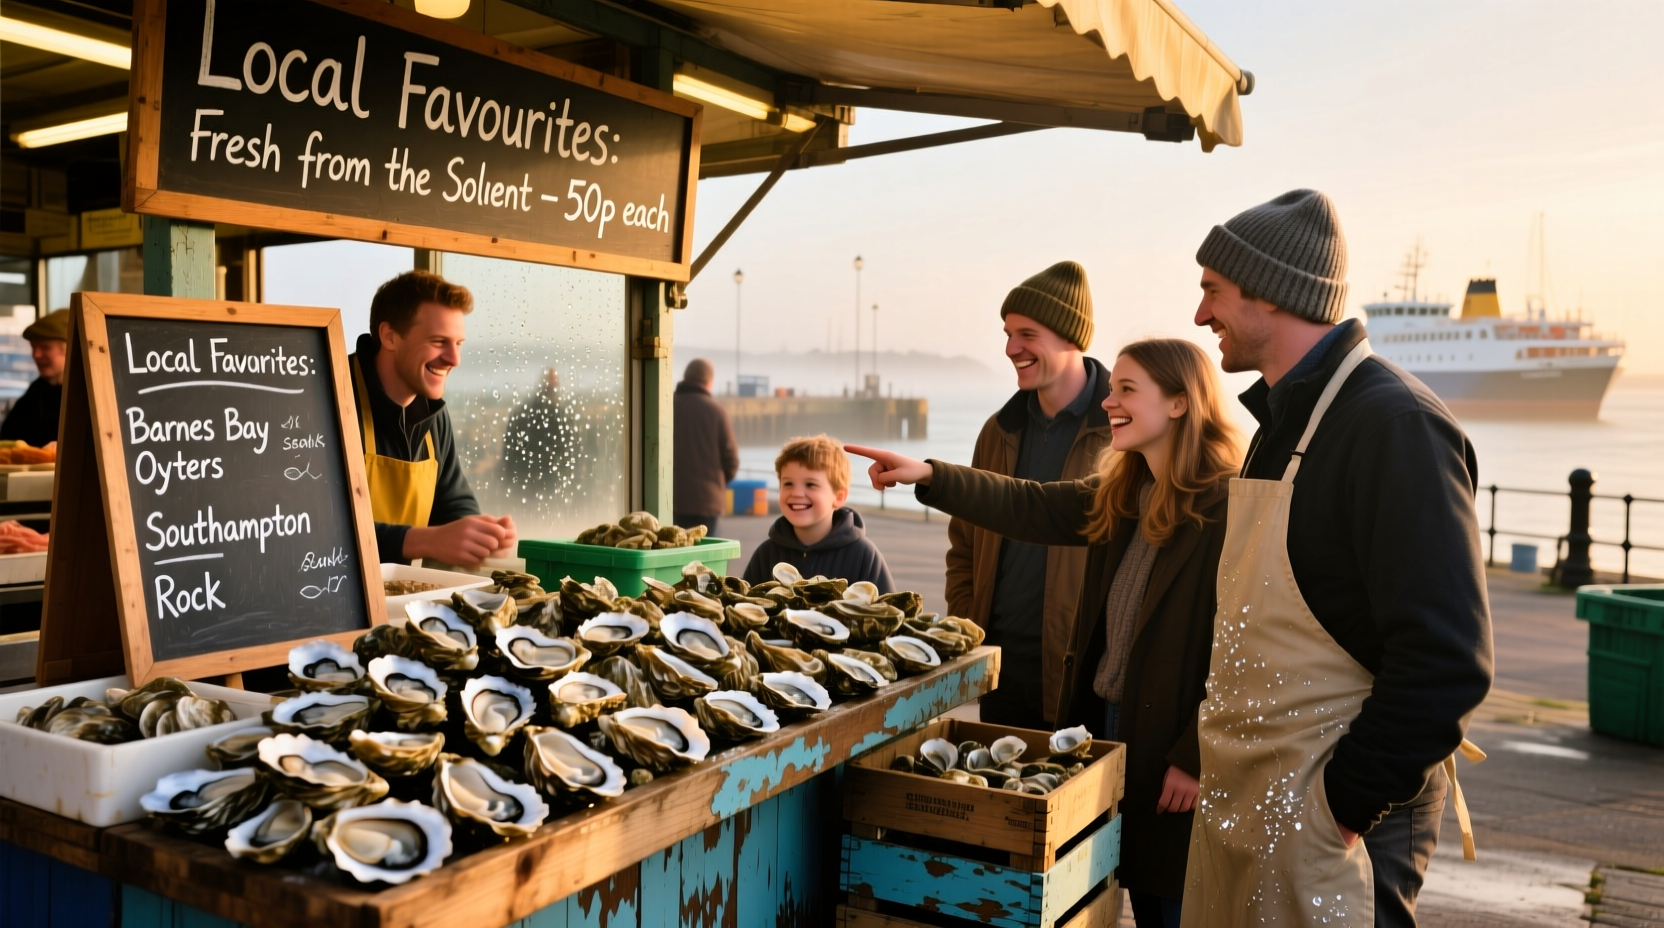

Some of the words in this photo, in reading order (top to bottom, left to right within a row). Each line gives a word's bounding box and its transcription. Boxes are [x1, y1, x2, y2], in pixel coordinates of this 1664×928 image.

[197, 0, 370, 119] Local
[398, 51, 621, 166] Favourites:
[190, 108, 281, 174] Fresh
[297, 130, 371, 189] from
[384, 147, 432, 196] the
[564, 178, 616, 239] 50p
[622, 193, 670, 234] each
[125, 332, 201, 374] Local
[126, 406, 215, 445] Barnes
[224, 407, 269, 455] Bay
[135, 450, 224, 496] Oyters
[145, 504, 312, 554] Southampton
[154, 571, 227, 620] Rock
